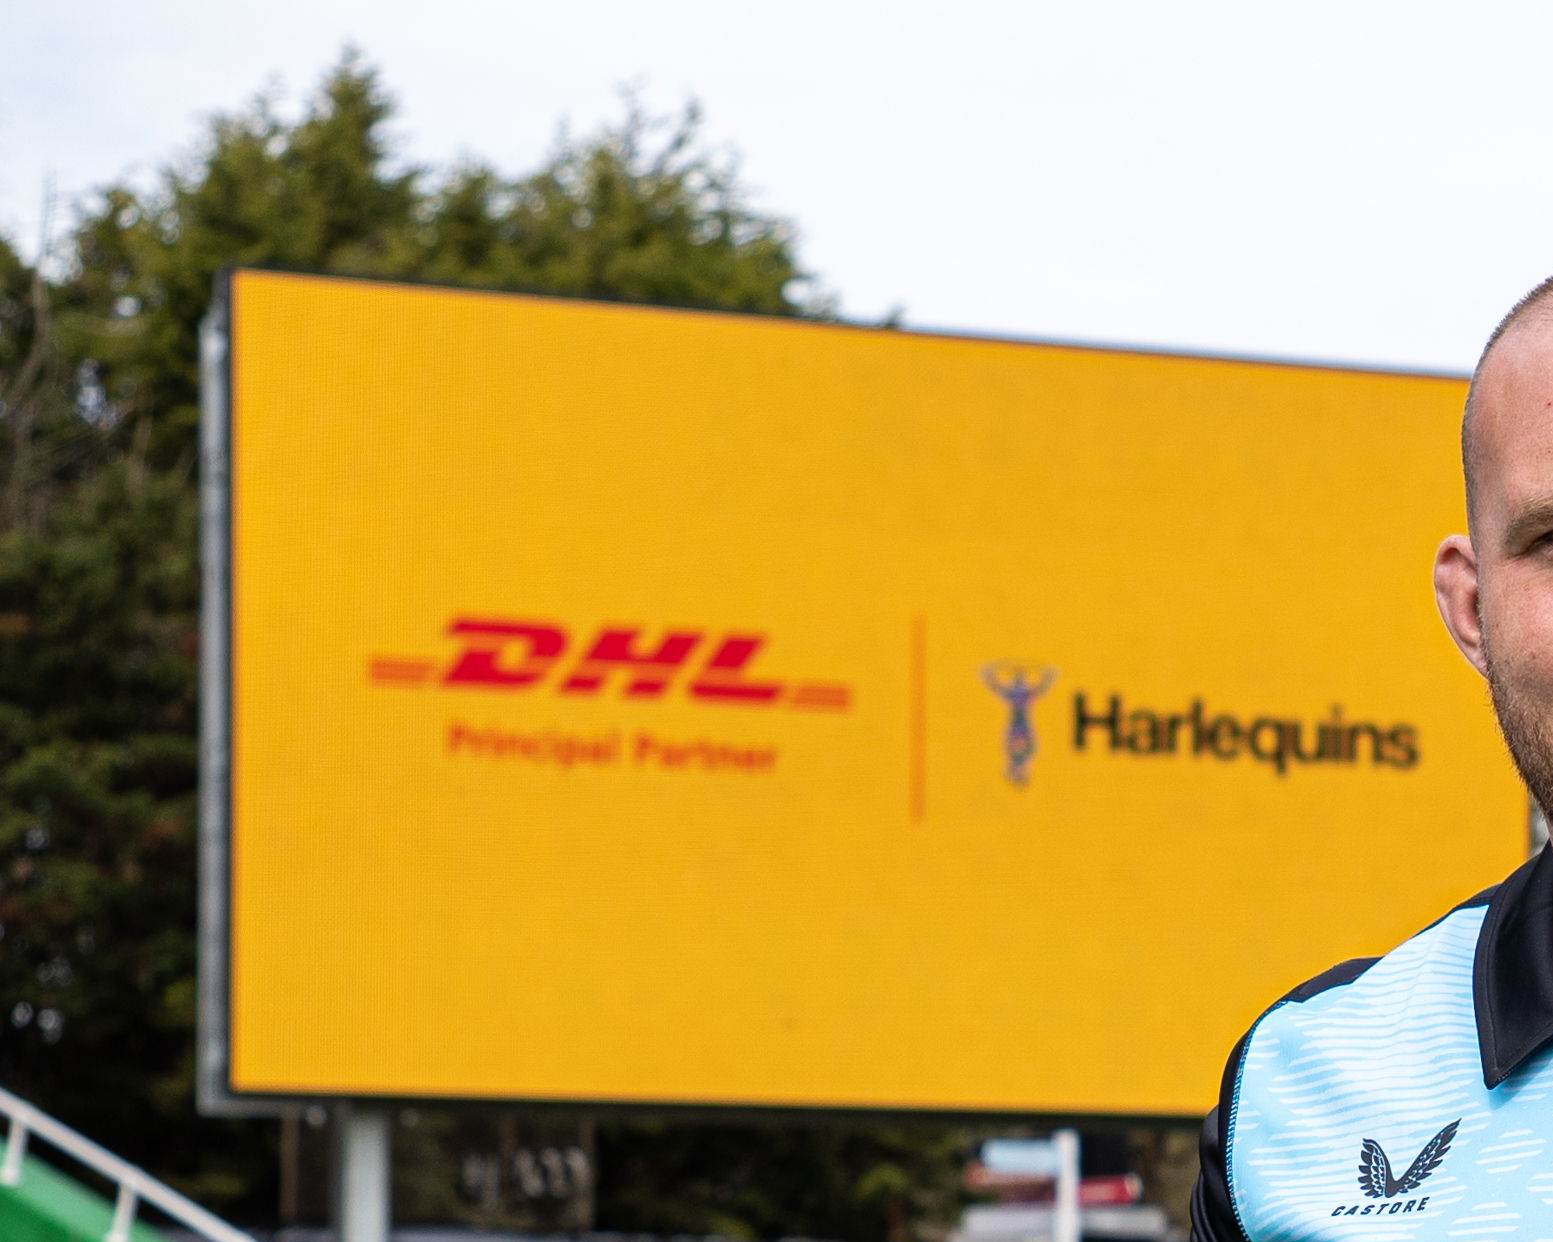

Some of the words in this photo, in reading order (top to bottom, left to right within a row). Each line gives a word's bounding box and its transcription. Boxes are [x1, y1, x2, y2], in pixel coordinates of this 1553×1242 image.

[441, 618, 783, 702] DHL
[1072, 694, 1420, 773] Harlequins
[1331, 1197, 1430, 1216] CASTORE
